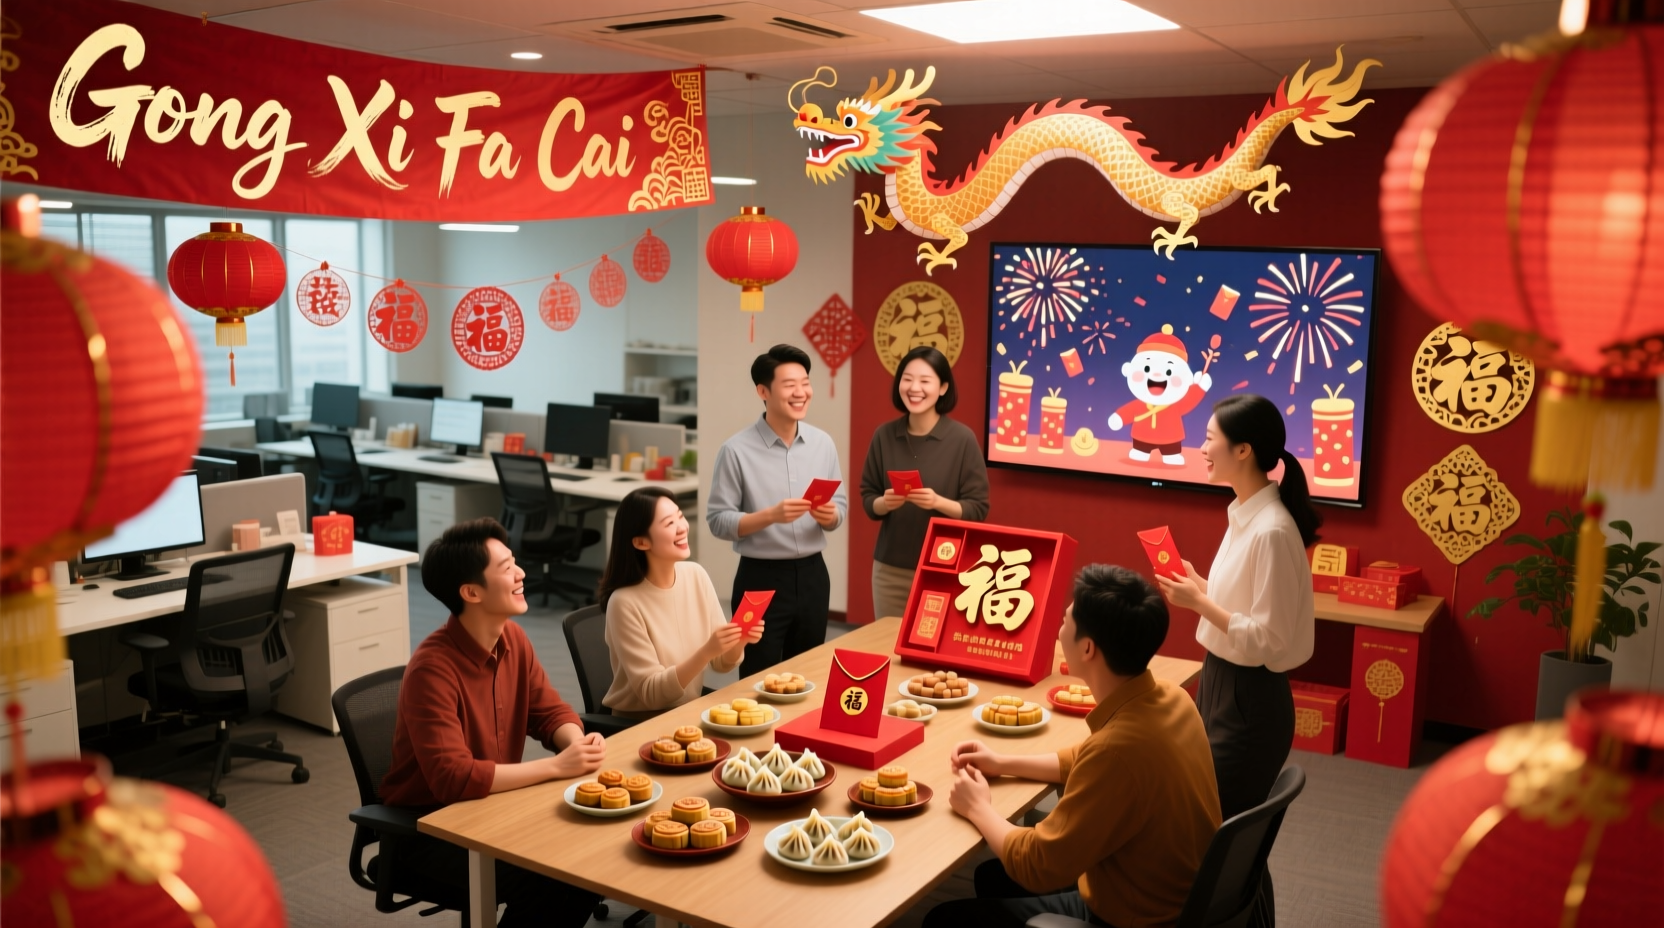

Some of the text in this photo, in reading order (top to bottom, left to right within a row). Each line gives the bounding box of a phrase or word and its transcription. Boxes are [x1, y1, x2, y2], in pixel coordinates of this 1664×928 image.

[49, 22, 636, 200] Gong Xi Fa Cai
[376, 292, 419, 345] 福
[466, 303, 509, 352] 福
[1431, 335, 1512, 415] 福
[1428, 472, 1492, 535] 福
[954, 544, 1035, 632] 福
[844, 690, 863, 711] 福
